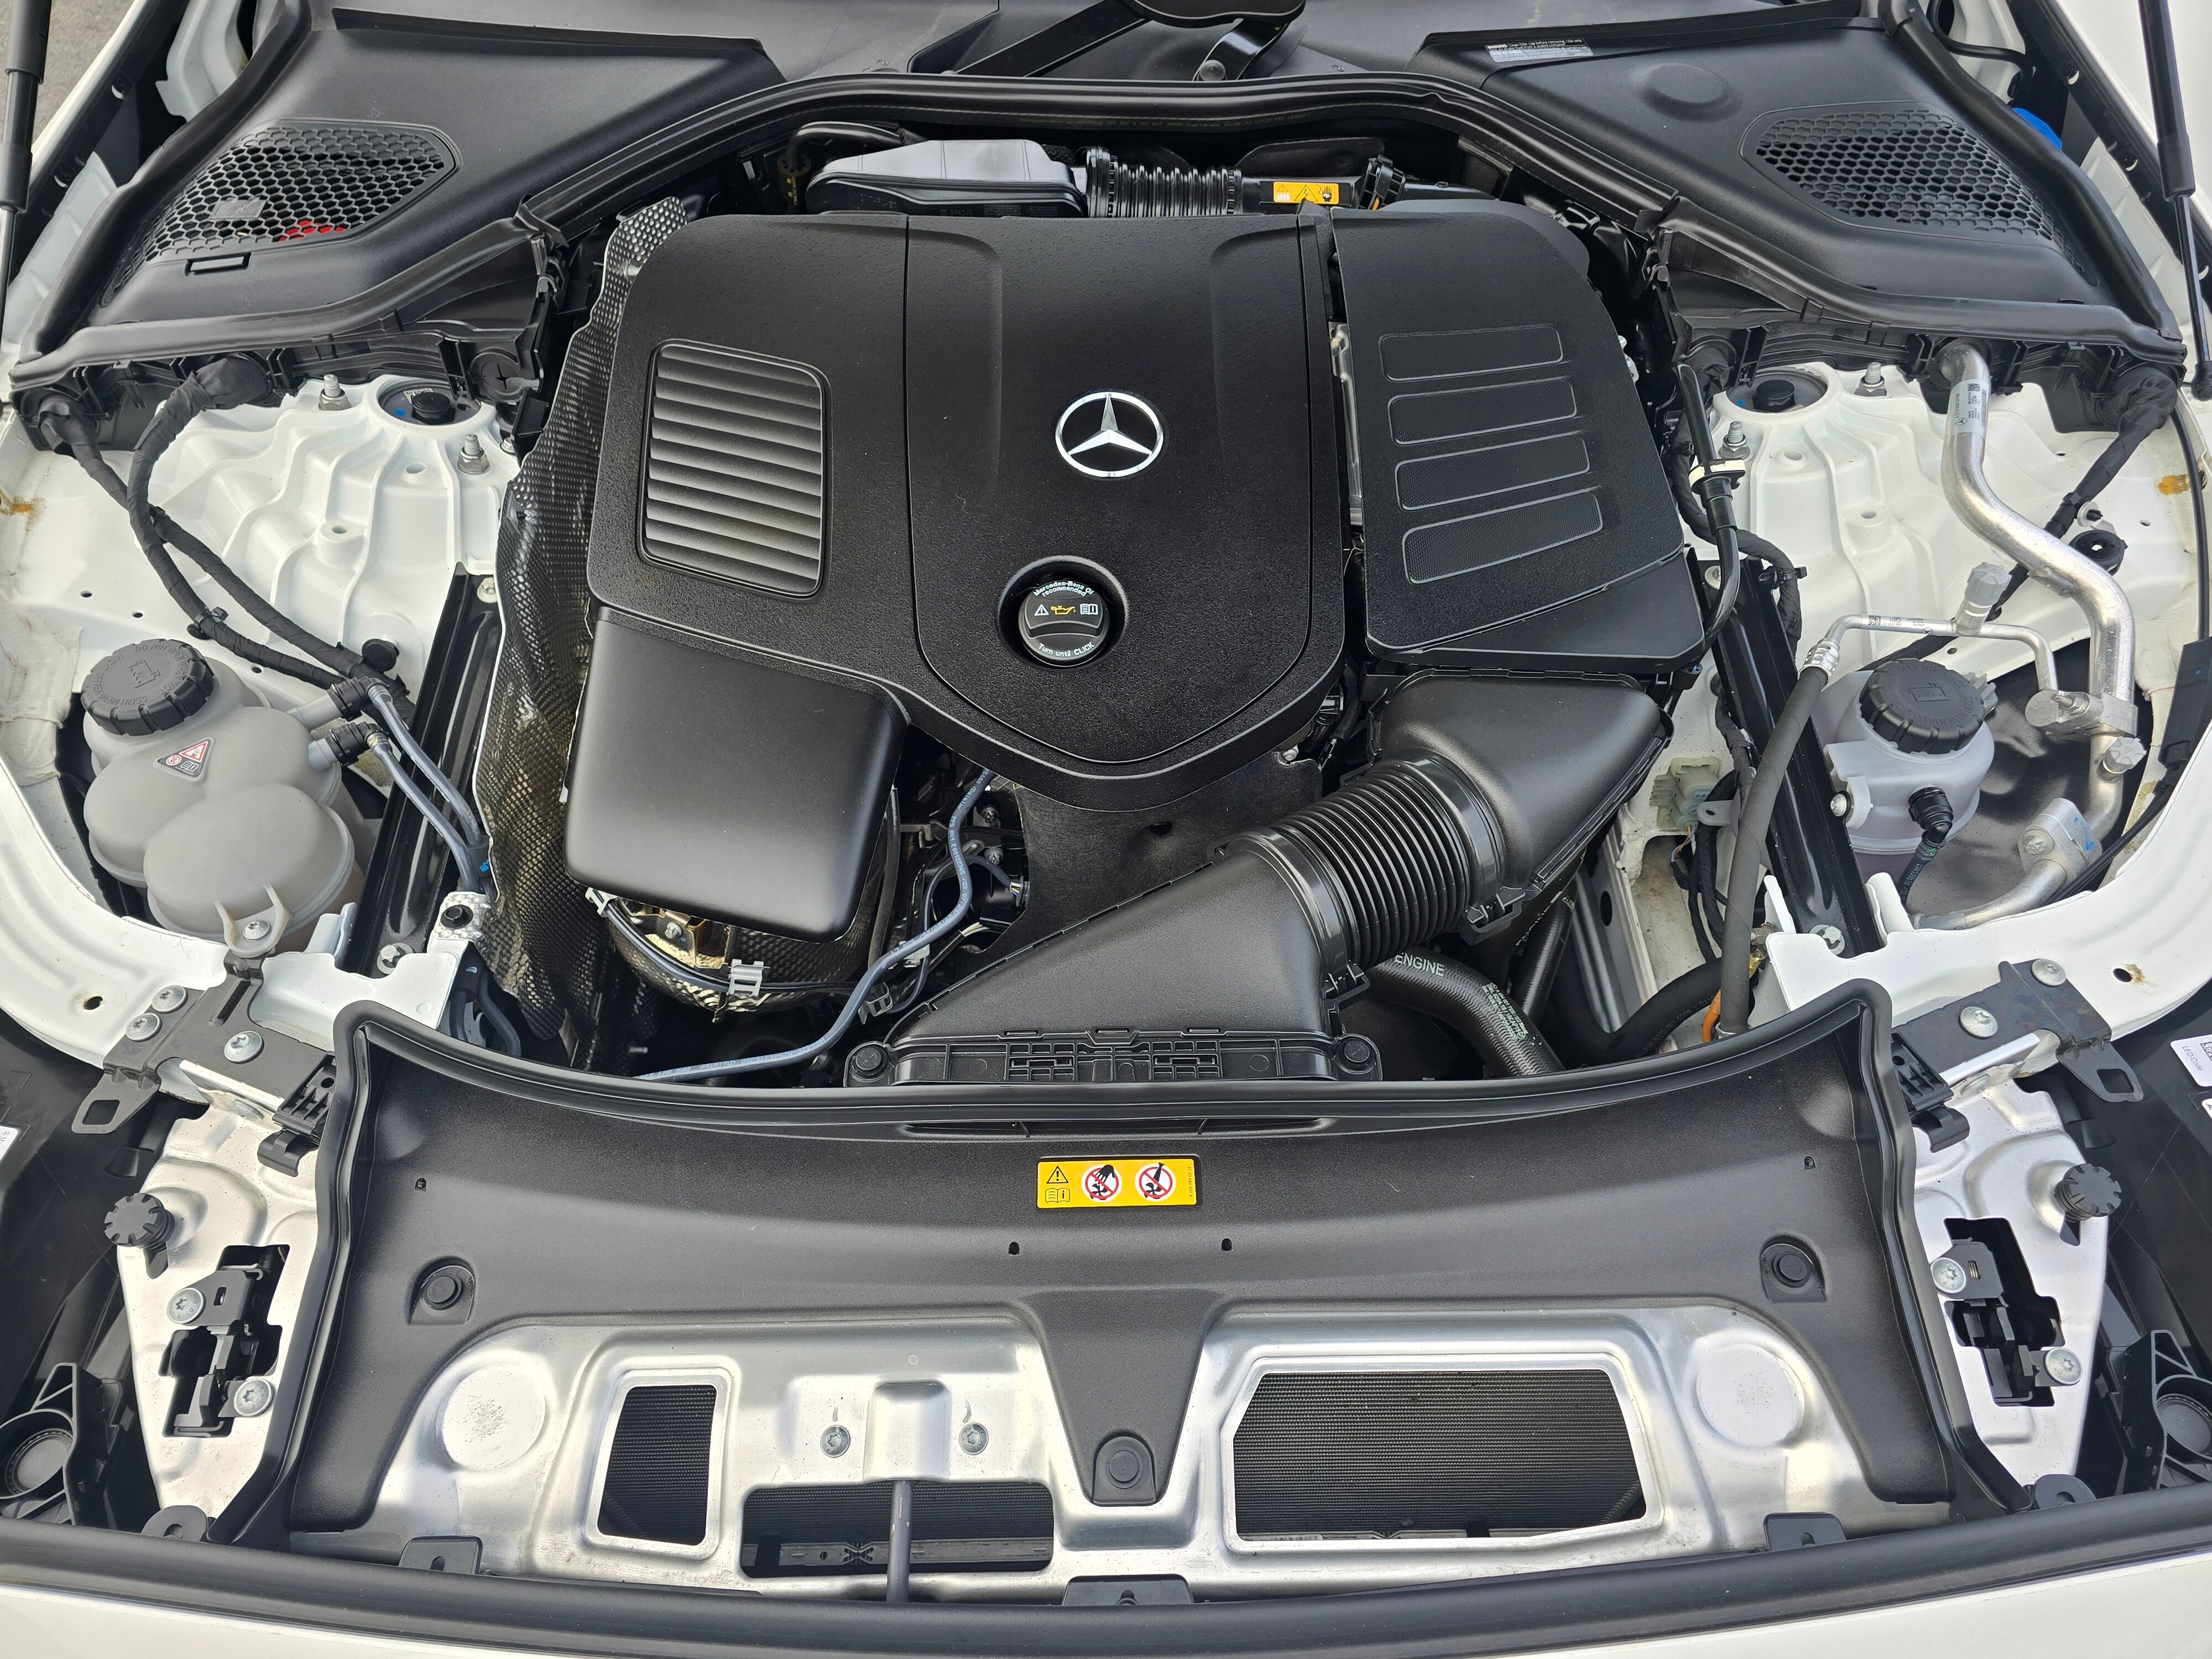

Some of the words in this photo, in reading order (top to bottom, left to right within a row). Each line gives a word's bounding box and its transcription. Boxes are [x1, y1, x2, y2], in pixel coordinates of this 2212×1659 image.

[1033, 581, 1085, 596] Mercedes-Benz
[1085, 586, 1094, 595] Oil
[1038, 643, 1053, 655] Turn
[1074, 641, 1095, 655] CLICK
[1394, 952, 1446, 978] ENGINE
[2182, 1046, 2203, 1071] LED-Code
